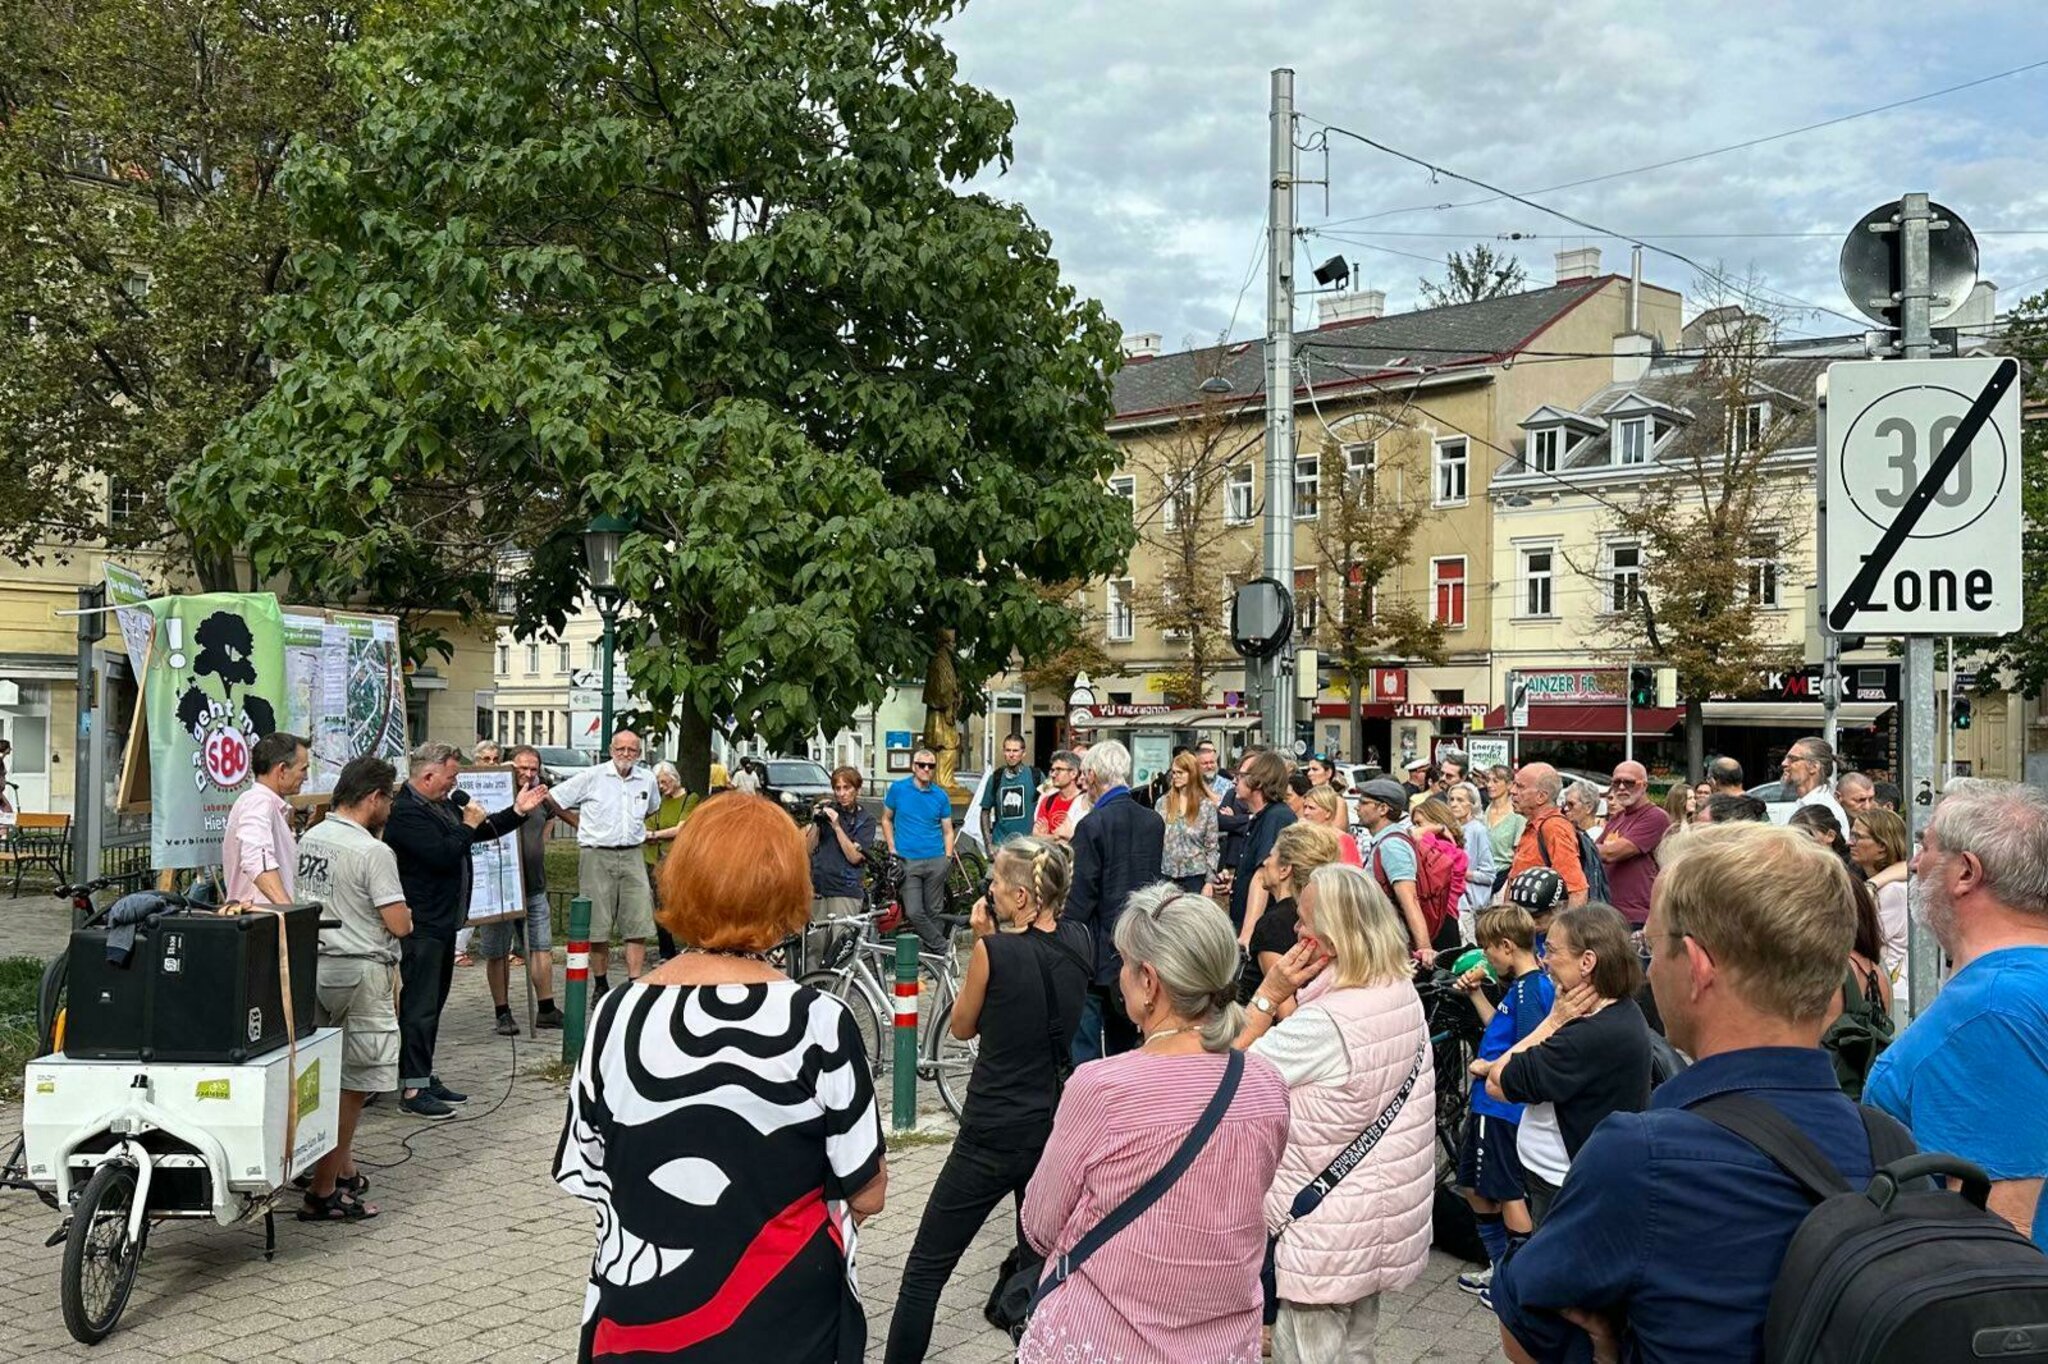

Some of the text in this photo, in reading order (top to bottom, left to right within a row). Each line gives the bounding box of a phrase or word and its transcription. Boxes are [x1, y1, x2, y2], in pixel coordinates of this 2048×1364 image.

[1875, 415, 1972, 508] 30
[1857, 688, 1886, 699] PIZZA
[1100, 704, 1115, 716] YU
[1394, 704, 1487, 717] YU TAEKWONDO
[208, 736, 246, 777] S80
[1313, 1176, 1331, 1198] K
